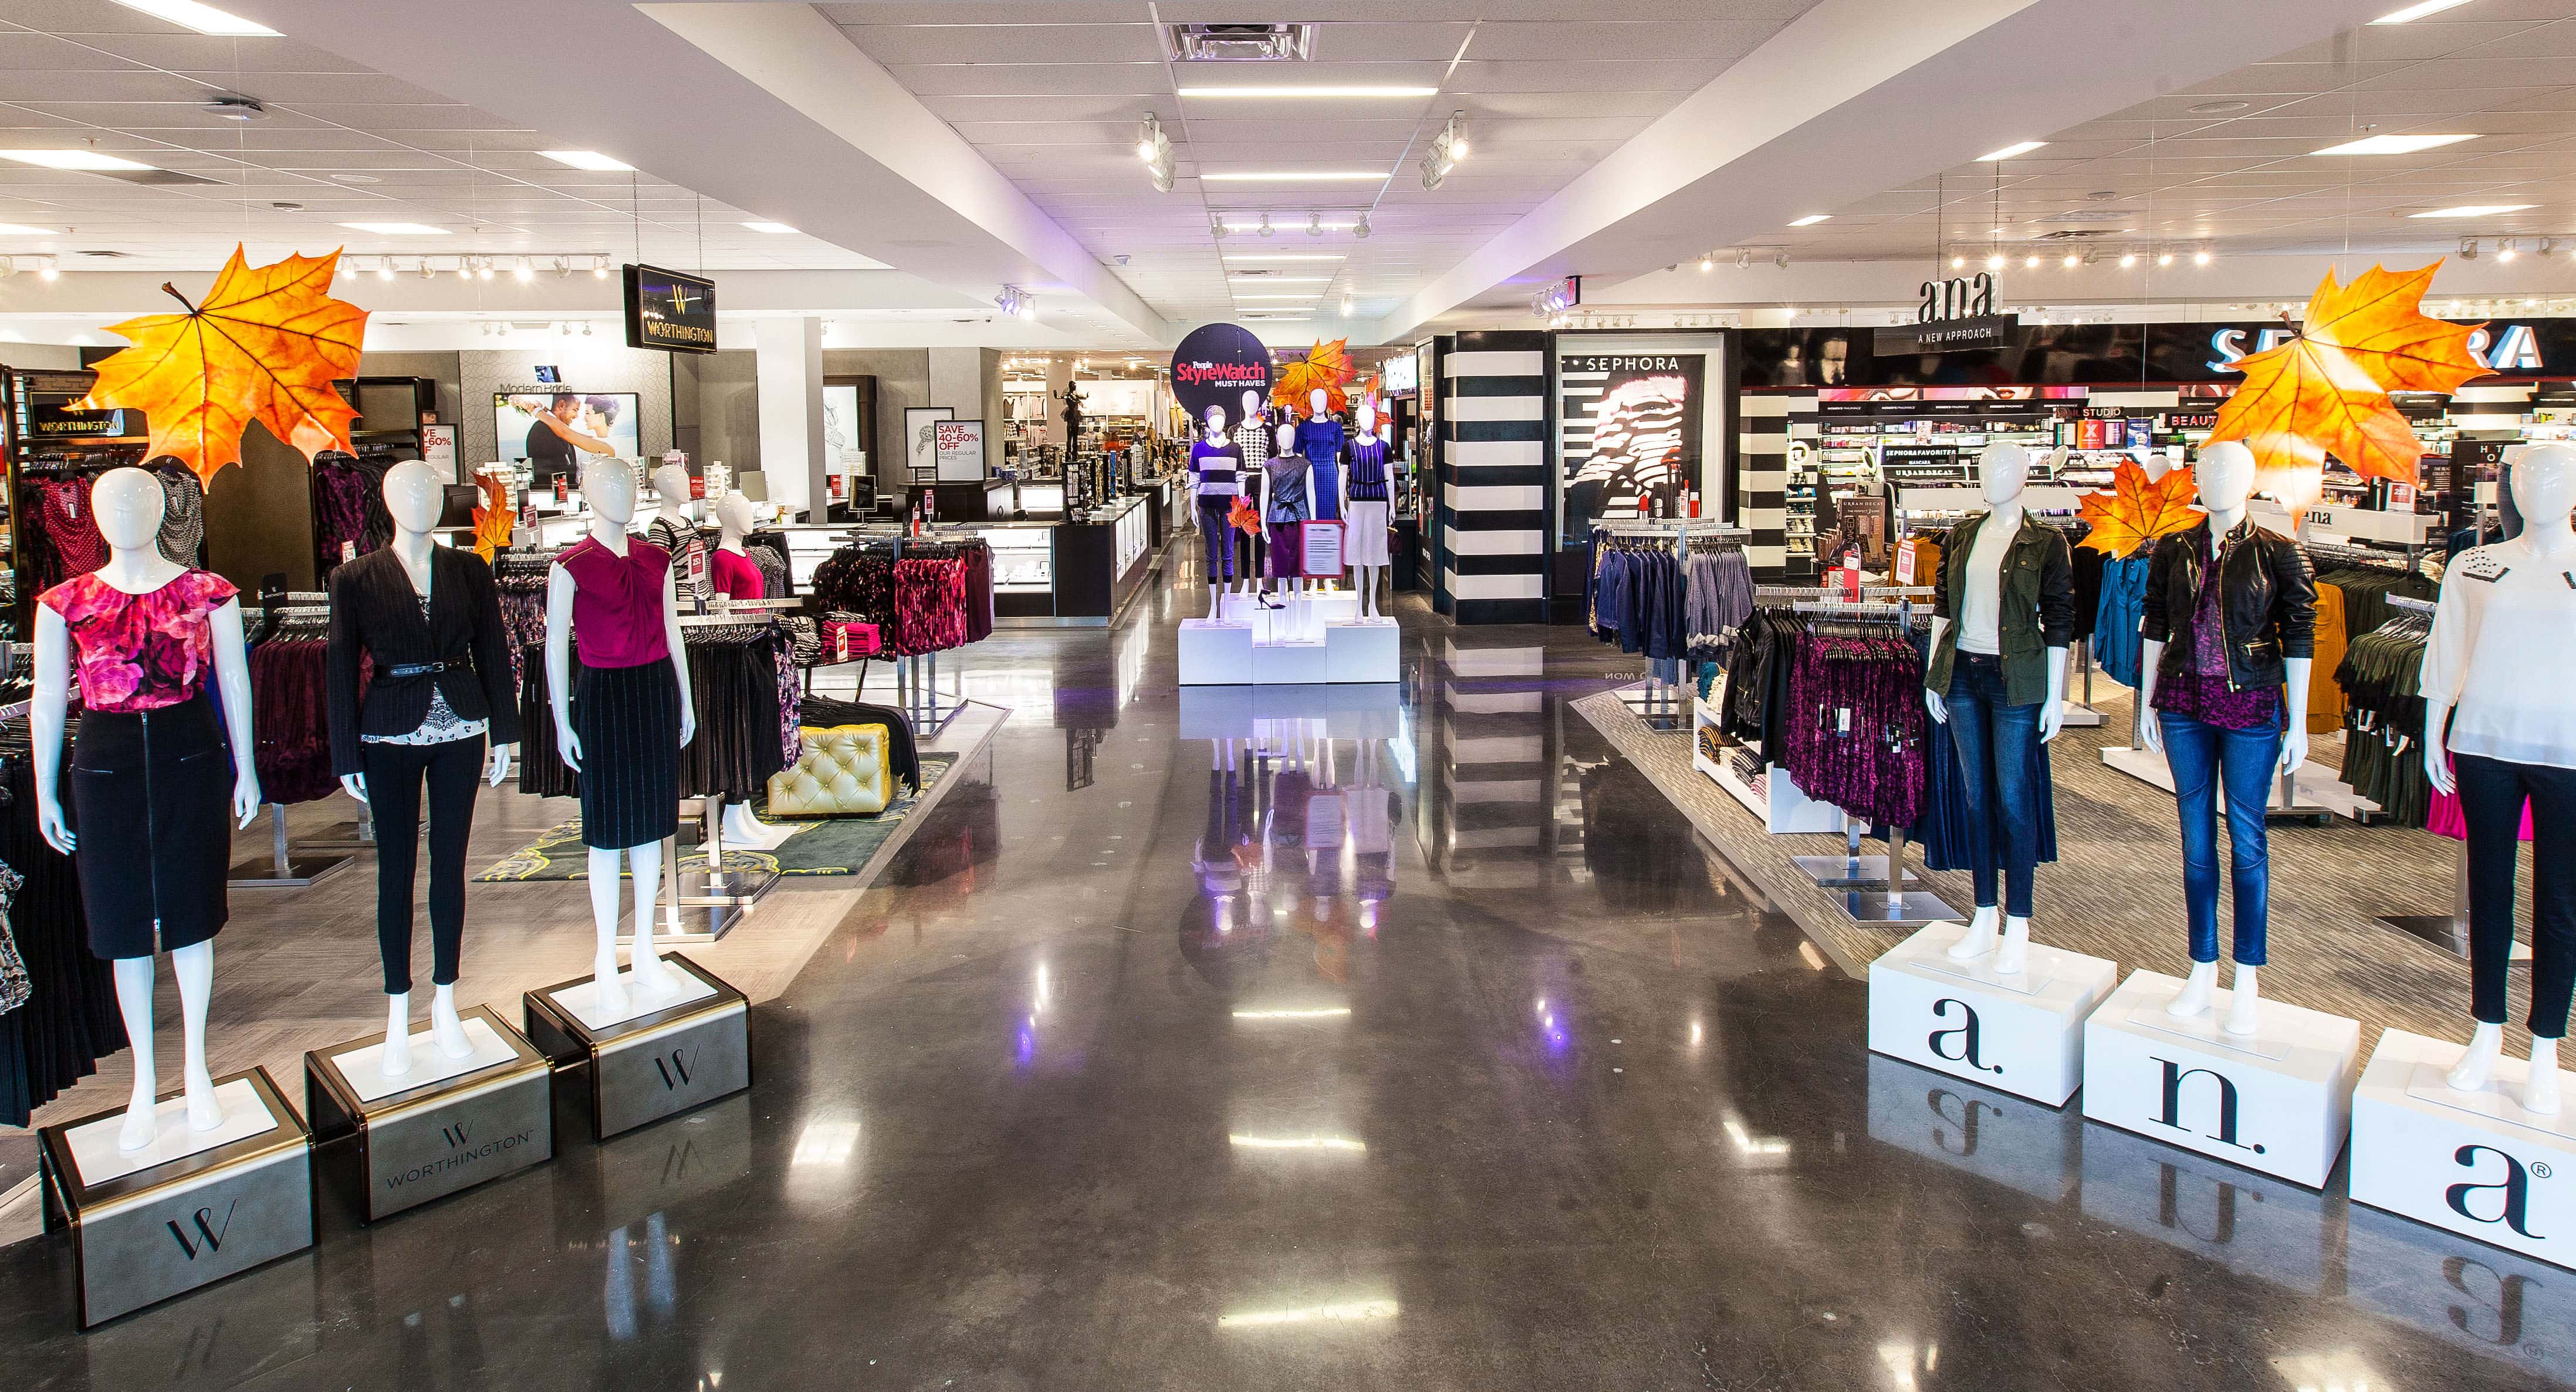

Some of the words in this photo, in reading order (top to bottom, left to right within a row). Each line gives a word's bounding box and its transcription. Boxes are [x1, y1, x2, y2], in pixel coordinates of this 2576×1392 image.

[671, 284, 688, 315] W
[1918, 272, 1993, 323] ana
[647, 320, 713, 343] WORTHINGTON
[1918, 334, 1923, 343] A
[1926, 332, 1942, 343] NEW
[1946, 327, 1992, 341] APPROACH
[1193, 361, 1213, 370] People
[1587, 357, 1679, 371] SEPHORA
[1177, 361, 1265, 385] StyleWatch
[500, 383, 543, 393] Modern
[544, 383, 573, 393] Bride
[2083, 408, 2121, 416] STUDIO
[39, 421, 118, 432] WORTHINGTON
[2172, 415, 2217, 427] BEAUT
[423, 429, 436, 437] VE
[938, 425, 965, 433] SAVE
[423, 437, 451, 446] -60%
[938, 433, 979, 442] 40-60%
[939, 442, 960, 451] OFF
[1846, 517, 1855, 544] NAKED
[655, 1044, 700, 1092] W
[442, 1119, 474, 1149] W
[386, 1130, 529, 1189] WORTHINGTON
[166, 1198, 238, 1261] W
